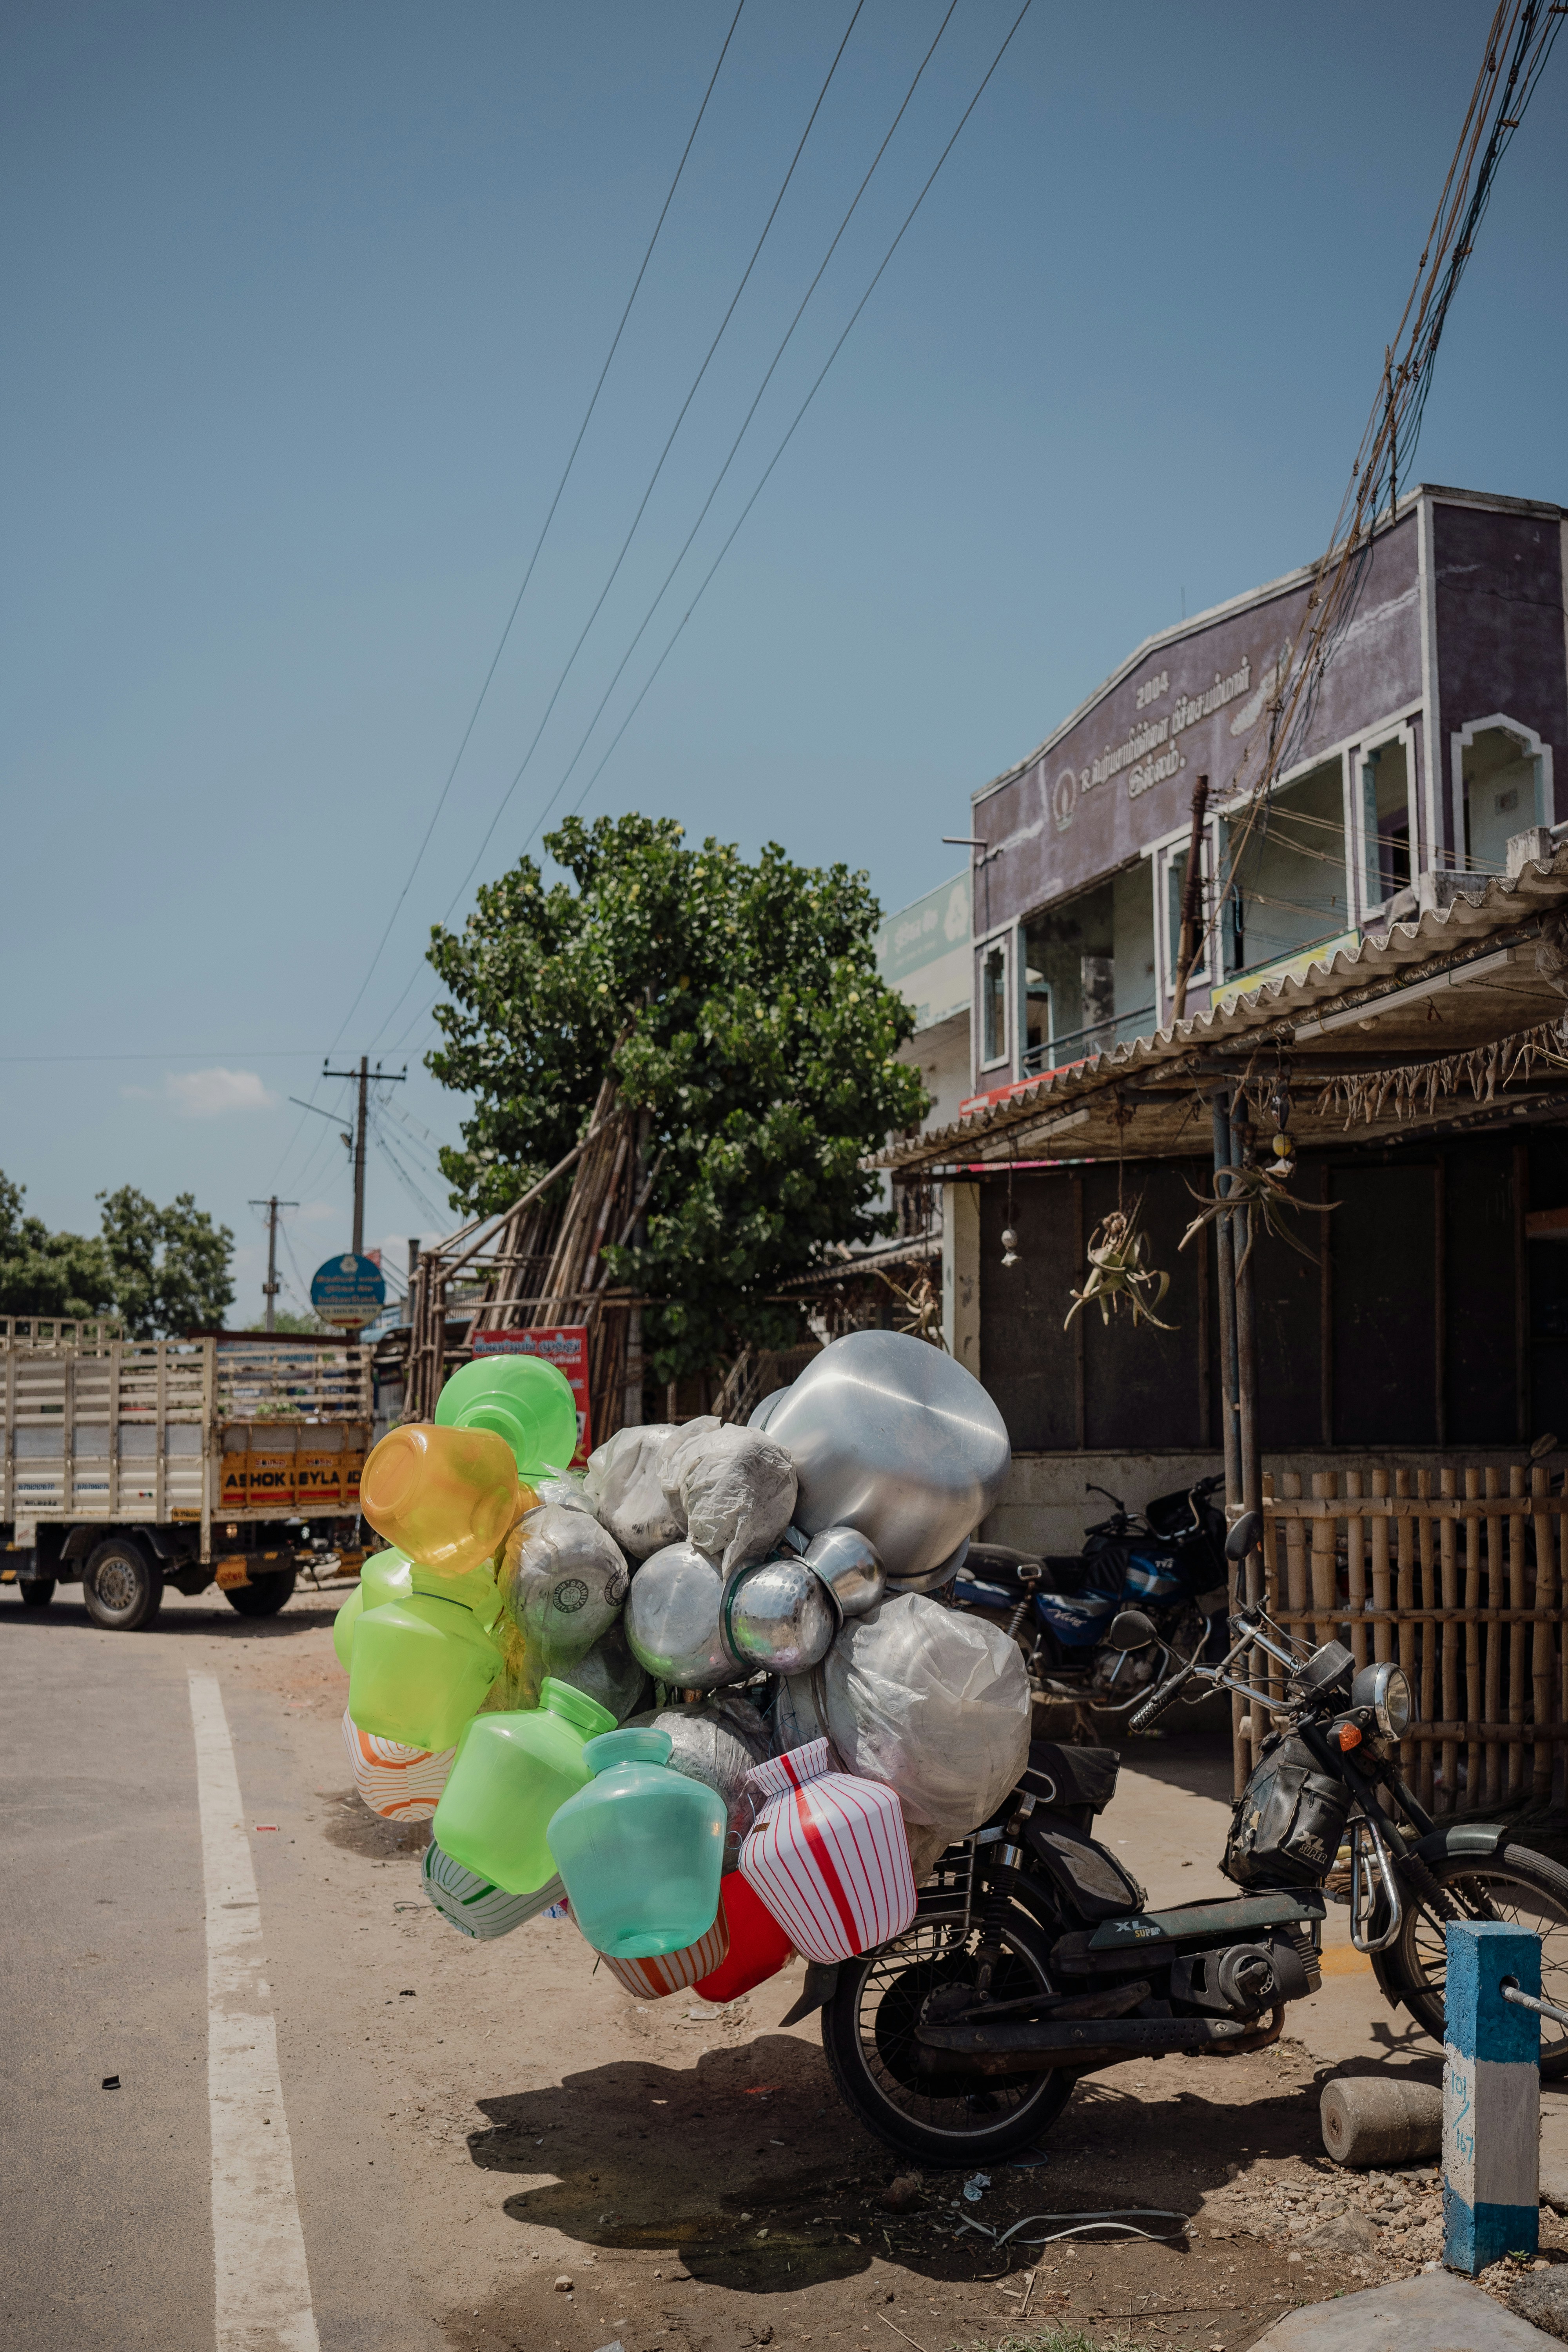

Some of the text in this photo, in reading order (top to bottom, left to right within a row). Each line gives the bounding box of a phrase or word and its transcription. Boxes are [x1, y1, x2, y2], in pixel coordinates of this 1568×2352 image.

[1136, 670, 1170, 710] 2004
[568, 1581, 588, 1611] SRINIVAS
[1296, 1830, 1324, 1851] XL
[1299, 1844, 1327, 1864] SUPER
[1113, 1920, 1149, 1932] XL
